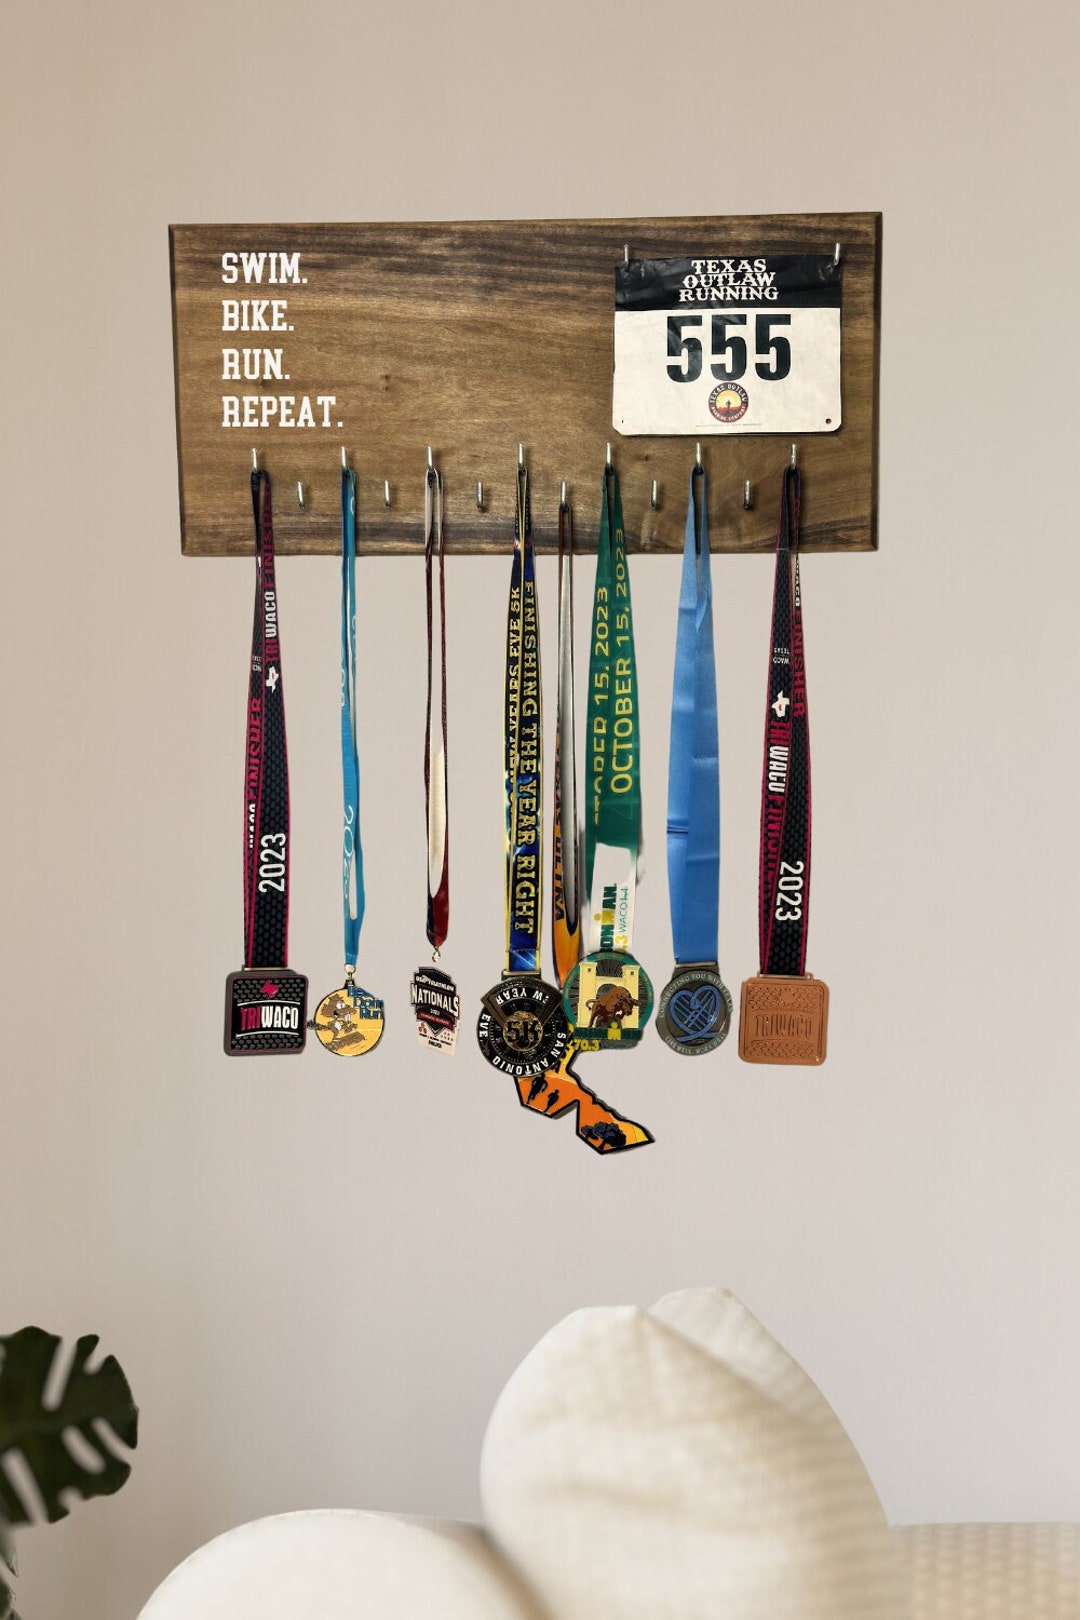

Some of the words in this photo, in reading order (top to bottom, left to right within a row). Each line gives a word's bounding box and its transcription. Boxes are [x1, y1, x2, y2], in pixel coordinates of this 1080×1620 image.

[222, 252, 308, 284] SWIM.
[682, 272, 775, 289] OUTLAW
[691, 258, 767, 275] TEXAS
[678, 286, 779, 302] RUNNING
[222, 300, 295, 331] BIKE.
[222, 348, 291, 380] RUN.
[666, 314, 791, 383] 555
[222, 396, 343, 428] REPEAT.
[615, 528, 627, 597] 2023
[510, 586, 521, 612] 5K
[594, 586, 609, 656] 2023
[616, 606, 630, 647] 15,
[509, 619, 521, 658] EVE
[522, 581, 538, 717] FINISHING
[793, 611, 807, 718] FINISHER
[611, 657, 633, 794] OCTOBER
[520, 723, 537, 774] THE
[517, 780, 537, 845] YEAR
[258, 832, 286, 893] 2023
[515, 855, 536, 934] RIGHT
[774, 860, 805, 921] 2023
[600, 886, 617, 952] ONMAN
[618, 902, 628, 933] WACO
[411, 983, 459, 1018] NATIONALS
[240, 1005, 299, 1031] TRIWACO
[479, 1013, 491, 1038] EVE
[506, 1020, 540, 1044] 5K
[754, 1013, 812, 1038] TRIWACO
[551, 1032, 567, 1058] SAN
[574, 1038, 600, 1052] 70.3
[492, 1055, 550, 1076] ANTONIO
